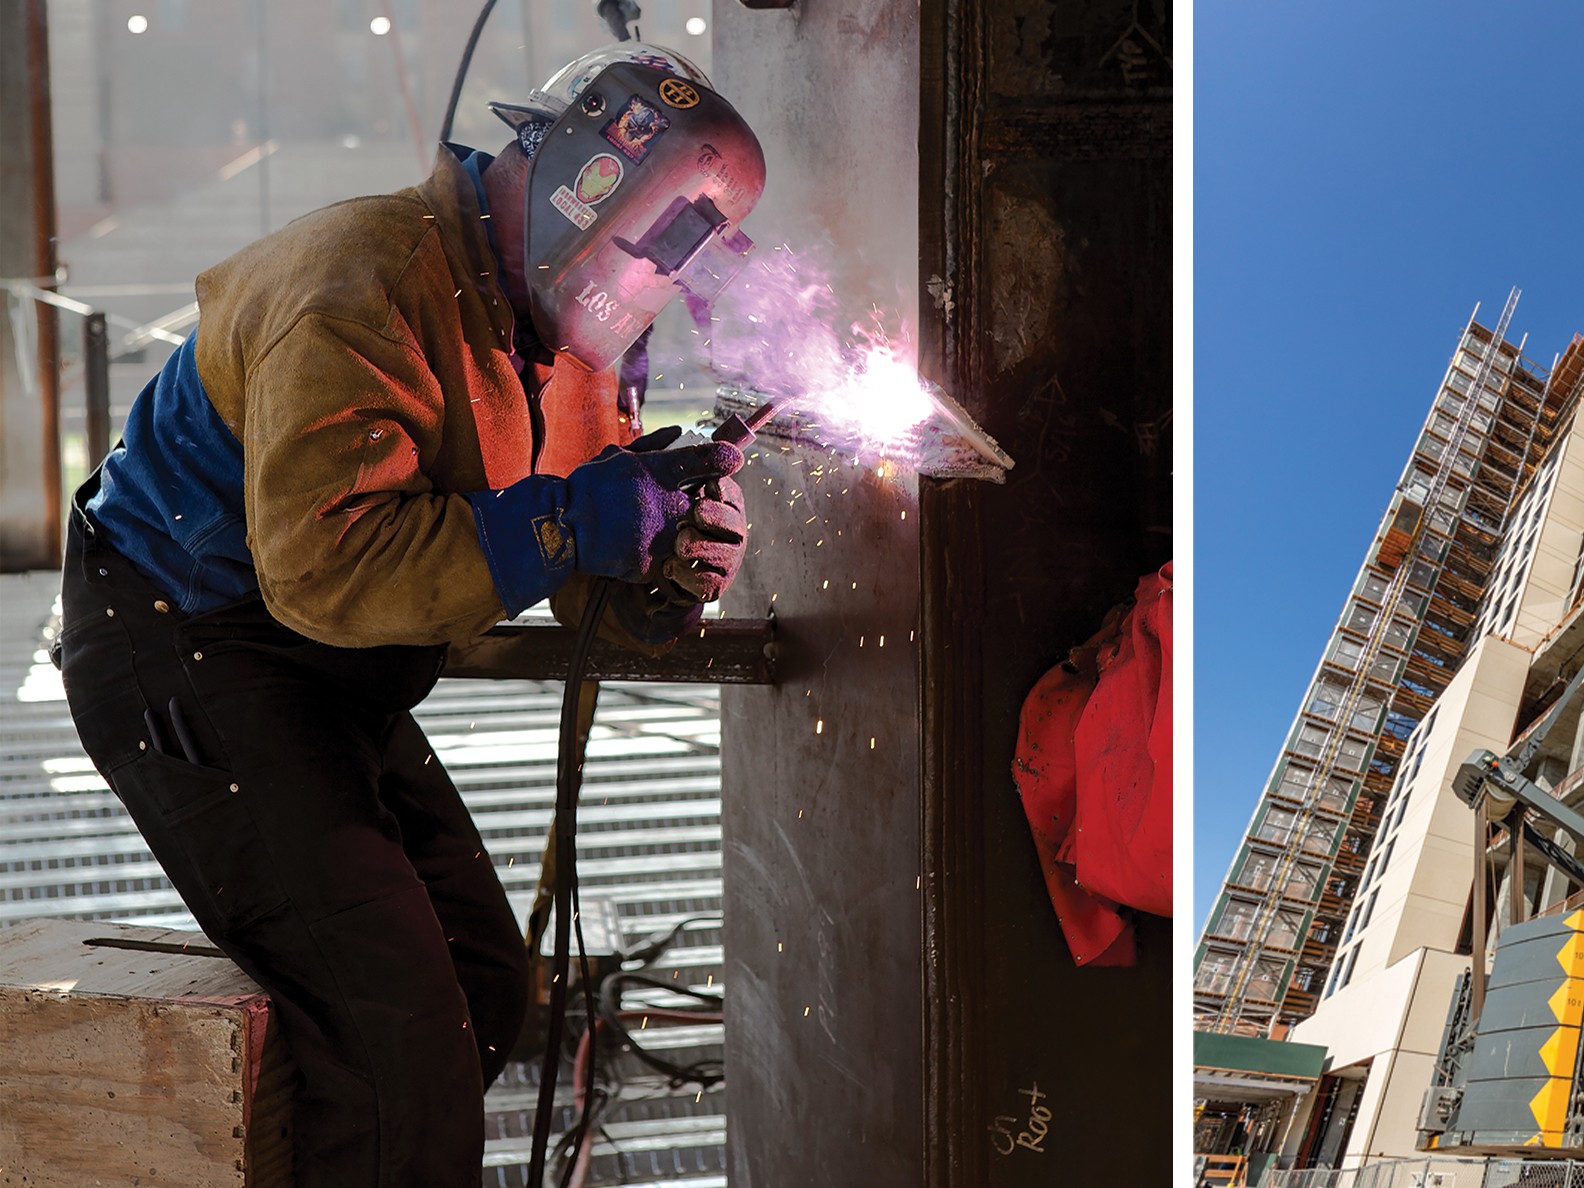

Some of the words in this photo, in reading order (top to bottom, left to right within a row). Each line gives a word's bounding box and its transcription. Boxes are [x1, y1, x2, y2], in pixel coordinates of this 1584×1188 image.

[552, 194, 573, 217] LOCAL
[575, 280, 620, 322] LOS
[1016, 1080, 1052, 1153] Root
